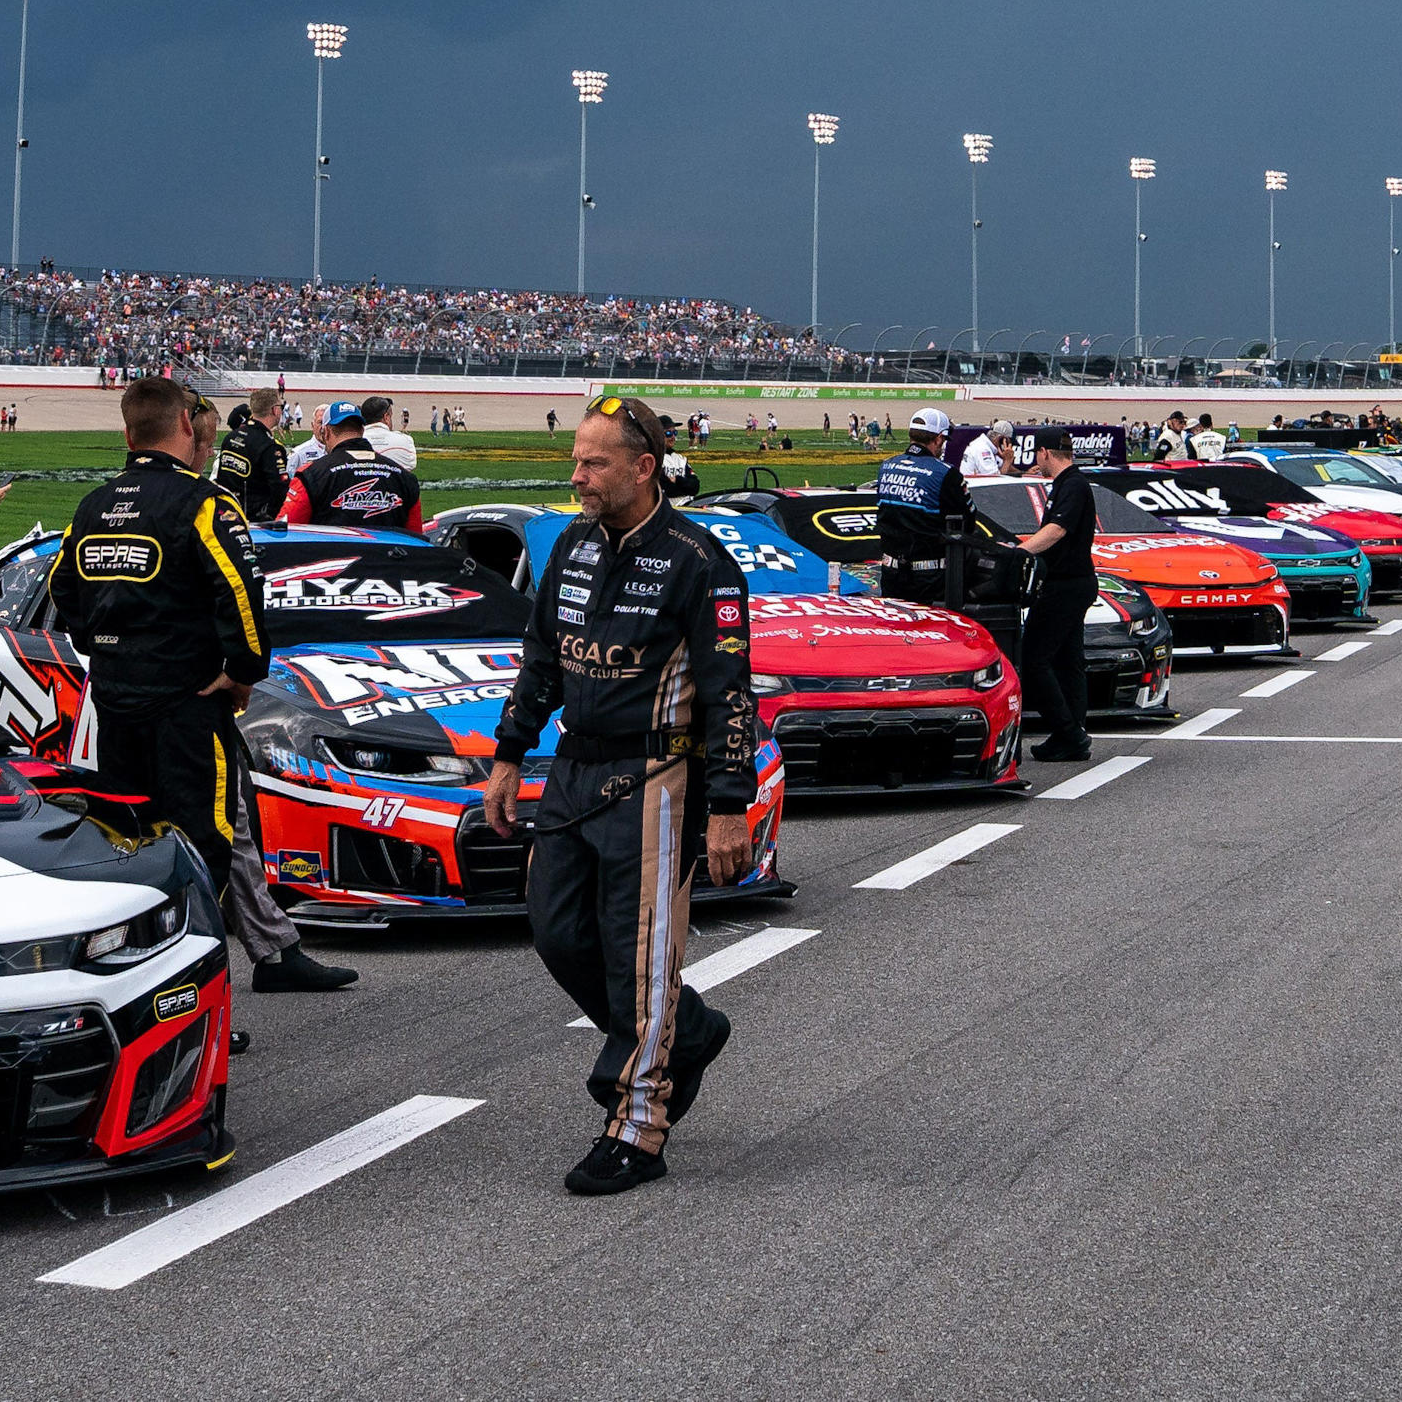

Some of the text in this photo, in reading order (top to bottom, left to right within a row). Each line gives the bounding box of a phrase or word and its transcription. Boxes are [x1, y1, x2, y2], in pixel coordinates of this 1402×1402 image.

[760, 387, 820, 398] RESTART ZONE
[880, 474, 918, 489] KAULIG
[343, 491, 398, 503] HYAK
[878, 485, 916, 500] RACING
[1125, 478, 1231, 516] ally
[263, 577, 453, 600] HYAK
[263, 596, 455, 610] MOTORSPORTS
[1180, 593, 1253, 604] CAMRY
[613, 604, 659, 616] DOLLAR TREE
[341, 682, 516, 726] ENERG
[362, 796, 407, 828] 47
[281, 862, 320, 875] SUNOCO
